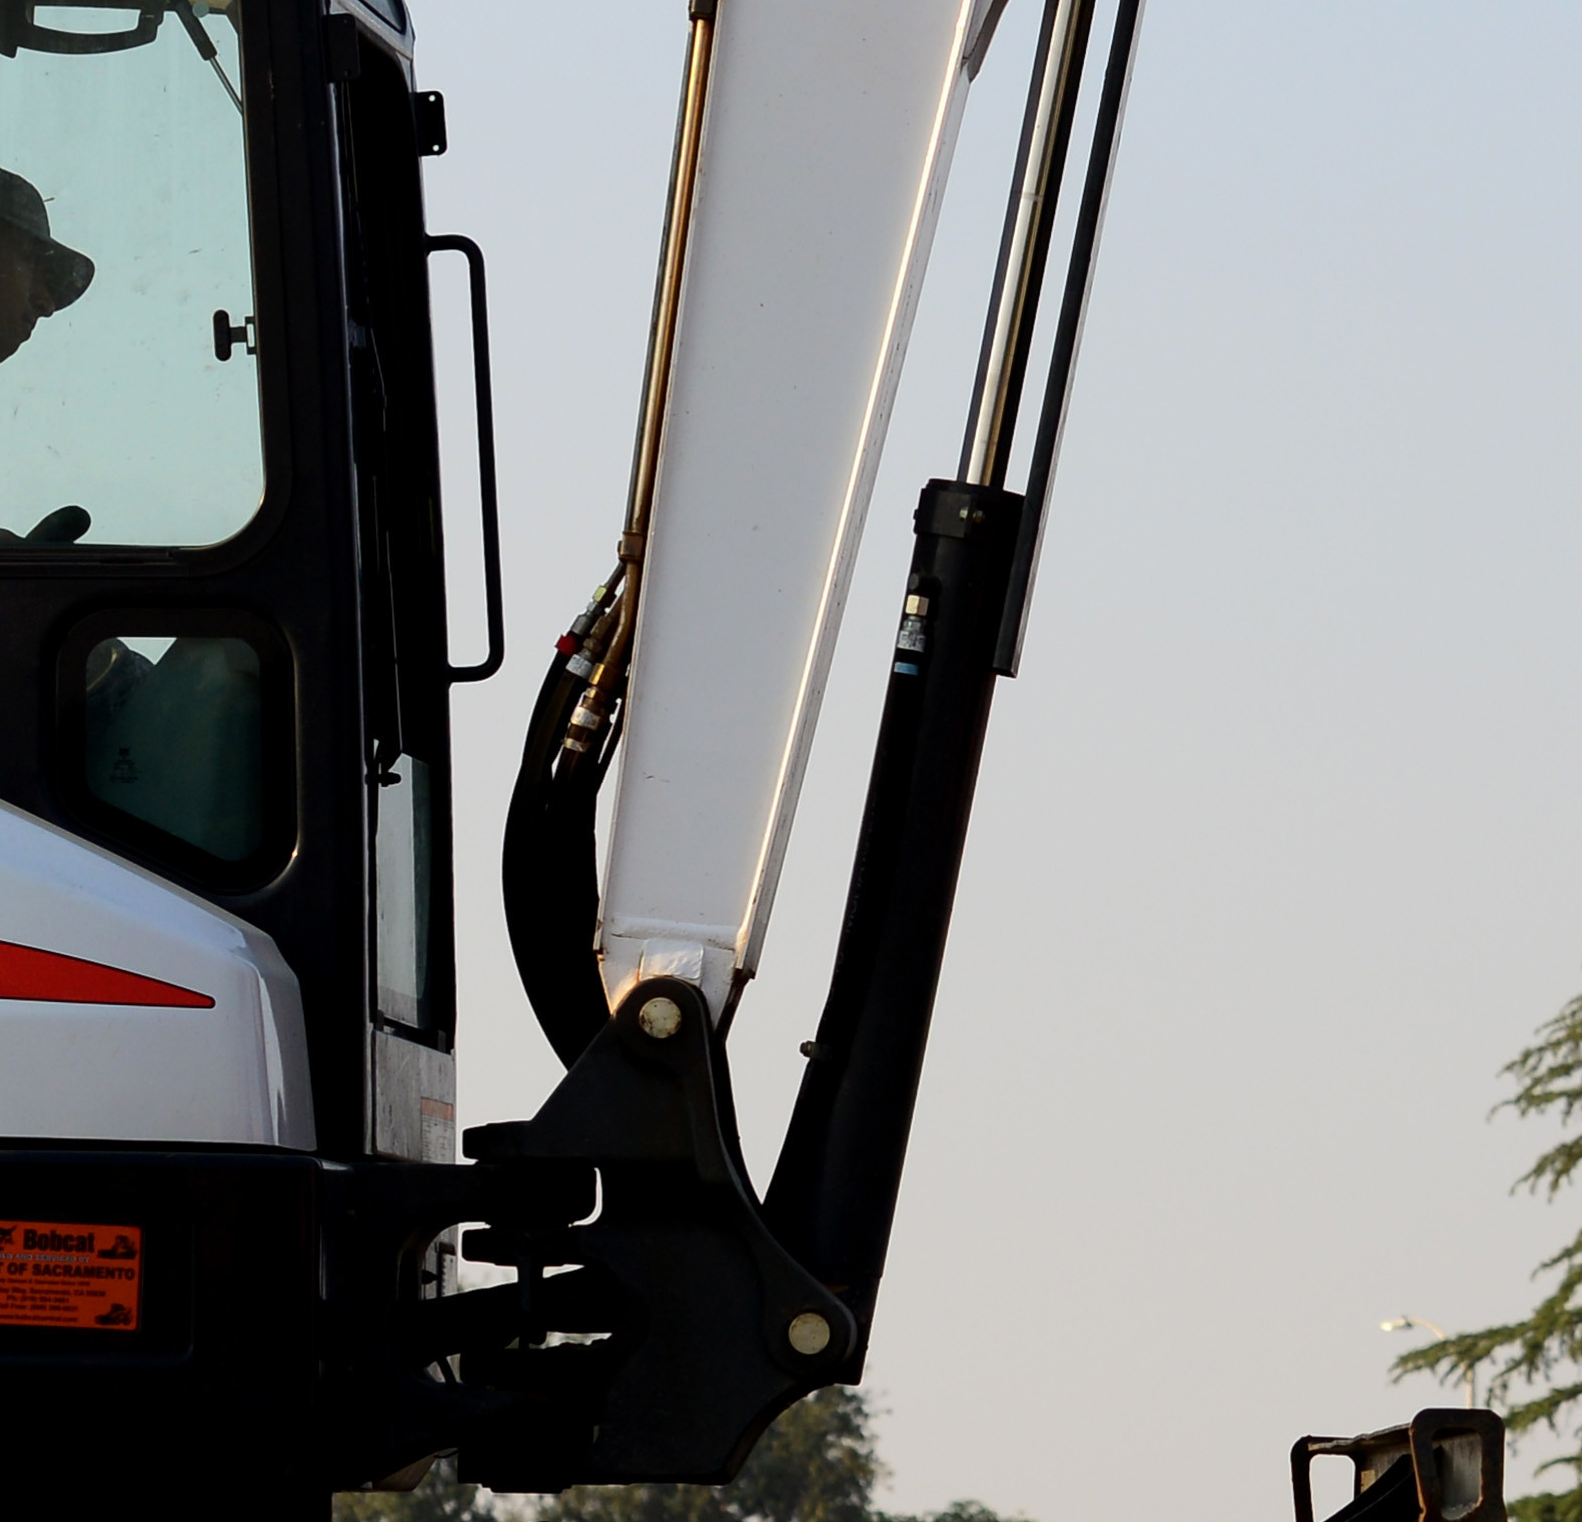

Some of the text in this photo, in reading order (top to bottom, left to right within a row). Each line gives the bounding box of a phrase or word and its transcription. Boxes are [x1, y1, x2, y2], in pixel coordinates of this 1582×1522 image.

[23, 1228, 96, 1253] Bobcat
[7, 1262, 28, 1276] OF
[31, 1264, 135, 1281] SACRAMENTO
